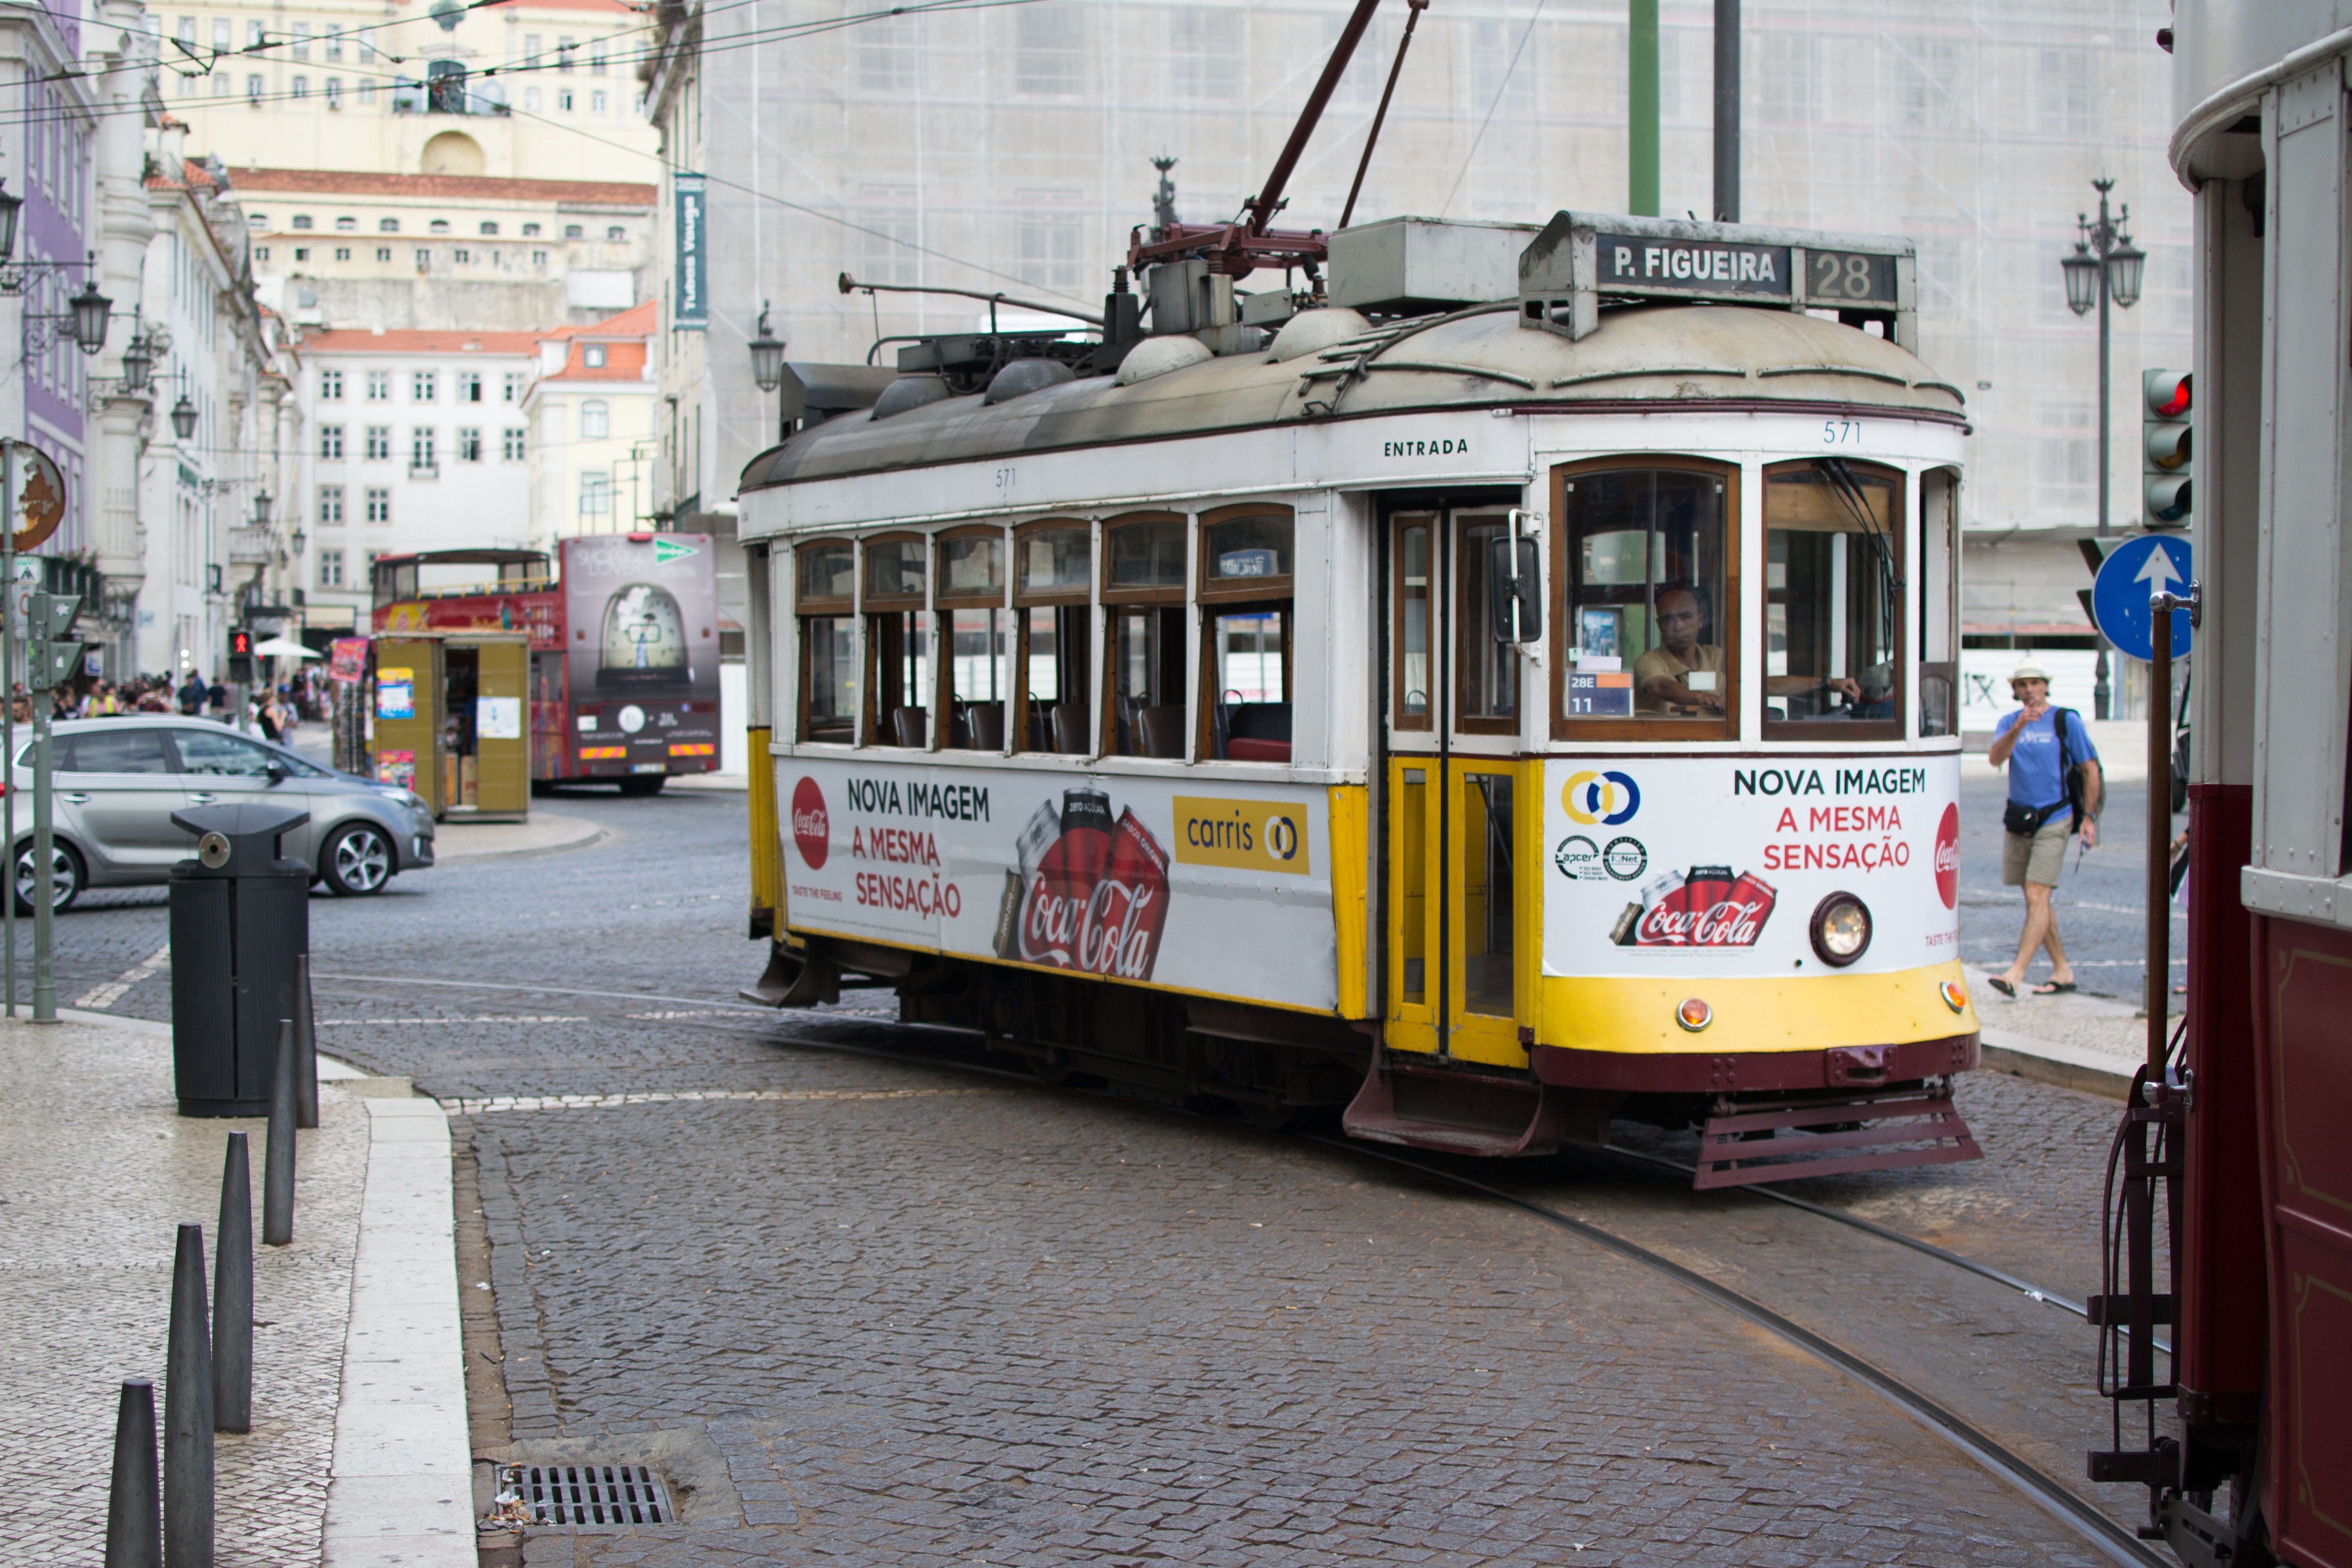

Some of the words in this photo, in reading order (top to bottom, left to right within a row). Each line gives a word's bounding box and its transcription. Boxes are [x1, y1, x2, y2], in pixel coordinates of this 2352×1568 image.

[1614, 246, 1635, 277] P.
[1645, 248, 1776, 282] FIGUEIRA
[1816, 253, 1871, 299] 28
[1824, 421, 1860, 443] 571
[1385, 438, 1468, 457] ENTRADA
[996, 468, 1015, 487] 571
[1571, 677, 1595, 688] 28E
[1572, 697, 1591, 713] 11
[1735, 770, 1825, 796] NOVA
[1836, 768, 1925, 795] IMAGEM
[848, 778, 902, 815] NOVA
[908, 782, 990, 822] IMAGEM
[1069, 802, 1083, 813] zero
[1188, 809, 1253, 851] carris
[1776, 807, 1798, 833] A
[1810, 805, 1902, 832] MESMA
[853, 825, 867, 859] A
[870, 827, 941, 867] MESMA
[1563, 853, 1592, 864] apcer
[1763, 835, 1910, 874] SENSAÇÃO
[792, 885, 808, 897] TASTE
[808, 888, 819, 899] THE
[856, 871, 961, 921] SENSAÇÃO
[1634, 901, 1763, 944] Coca-Cola
